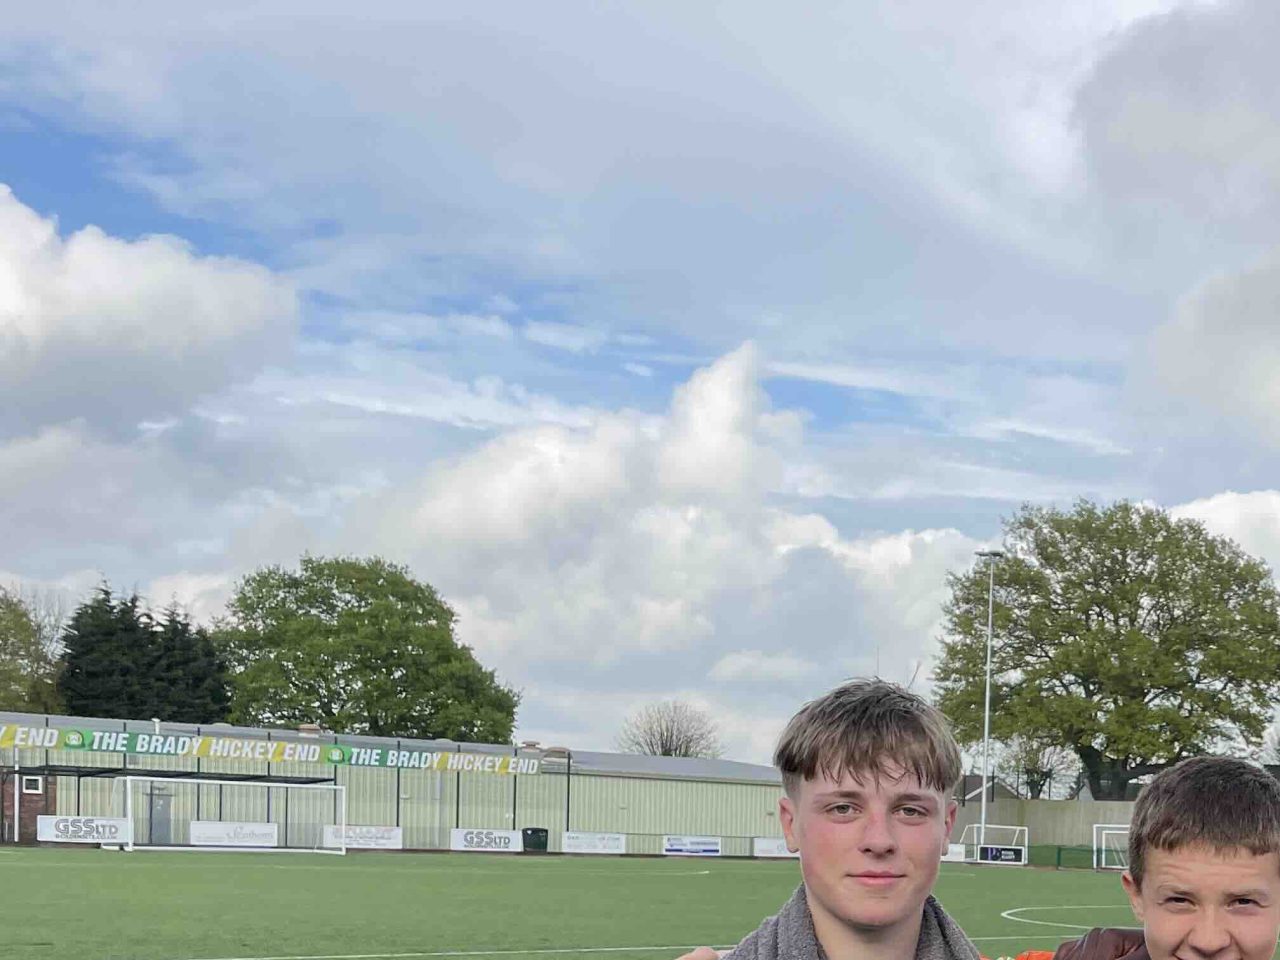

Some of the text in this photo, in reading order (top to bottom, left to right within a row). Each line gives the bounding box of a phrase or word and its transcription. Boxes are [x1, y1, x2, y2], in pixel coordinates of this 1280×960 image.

[15, 727, 59, 748] END
[92, 731, 320, 762] THE BRADY HICKEY END
[350, 747, 539, 775] THE BRADY HICKEY END
